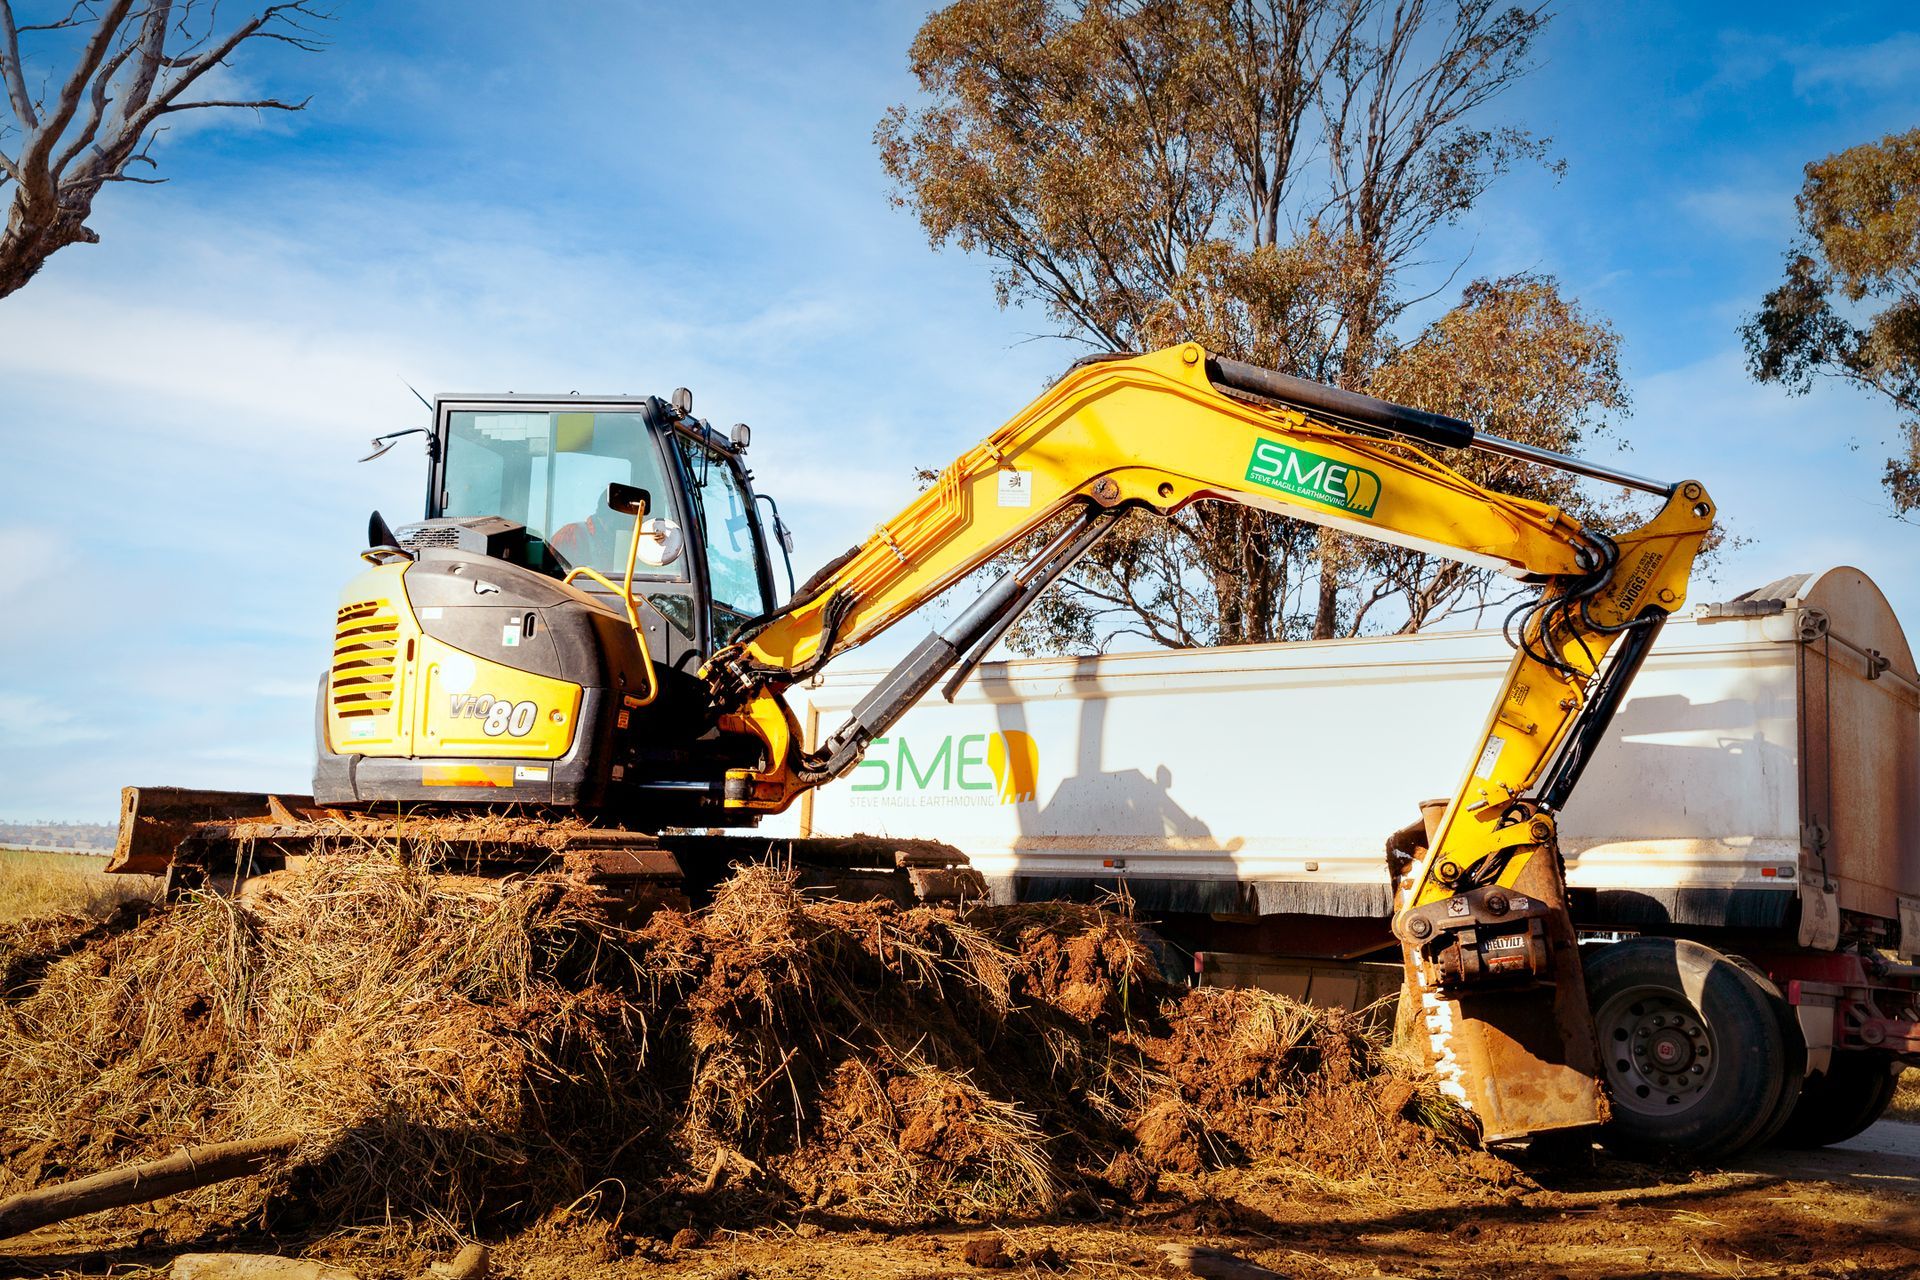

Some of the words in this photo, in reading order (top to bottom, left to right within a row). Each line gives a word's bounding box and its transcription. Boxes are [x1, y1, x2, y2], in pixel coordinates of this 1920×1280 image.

[1252, 443, 1348, 498] SME
[1250, 472, 1271, 484] STEVE
[1272, 478, 1296, 492] MAGILL
[1296, 486, 1345, 506] EARTHMOVING
[1640, 552, 1657, 575] CAPACITY
[1651, 552, 1664, 570] RATED
[1619, 576, 1647, 611] 590KG
[851, 734, 993, 792] SME
[850, 796, 879, 808] STEVE
[881, 795, 918, 808] MAGILL
[919, 794, 995, 808] EARTHMOVING
